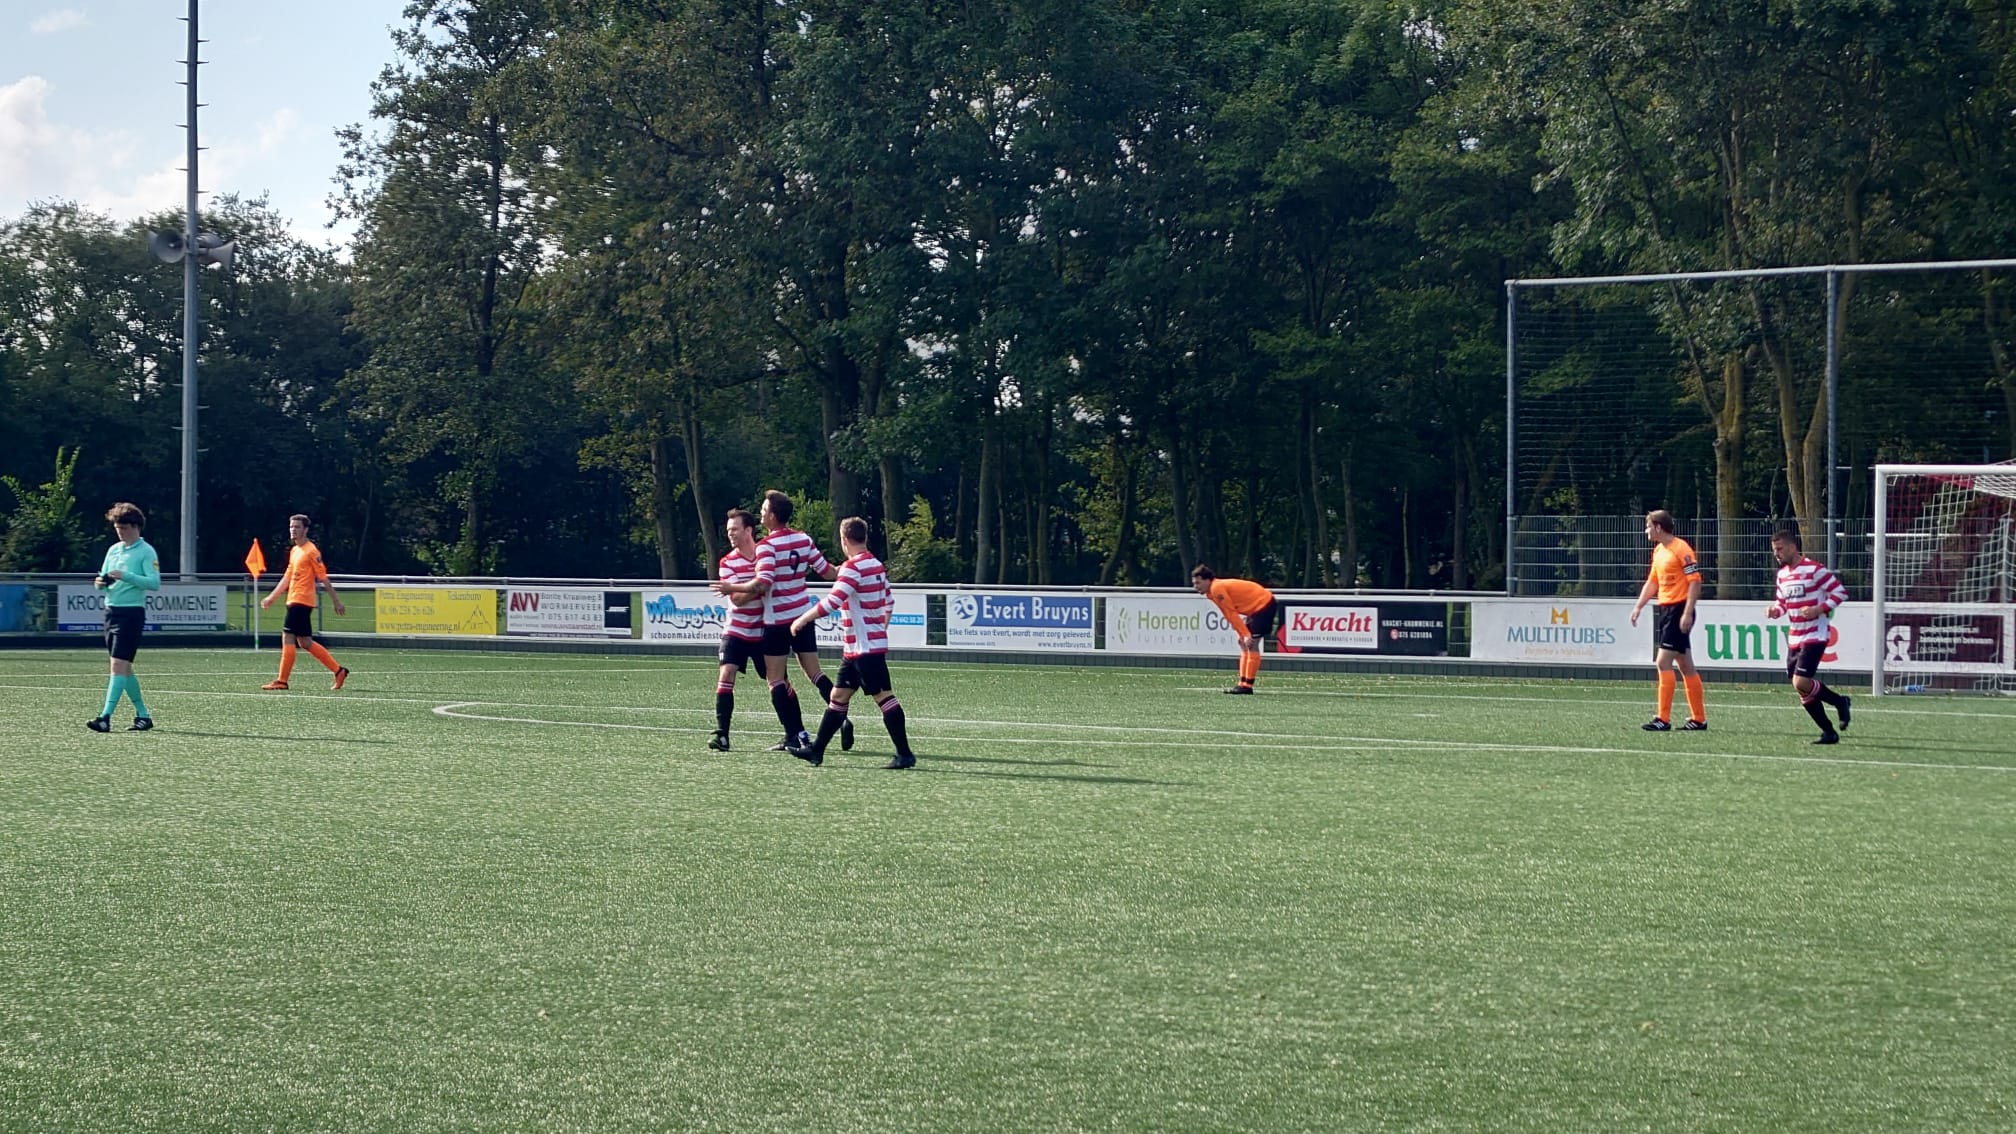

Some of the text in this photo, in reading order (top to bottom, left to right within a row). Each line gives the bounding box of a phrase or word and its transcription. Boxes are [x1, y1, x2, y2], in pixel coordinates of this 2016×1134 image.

[789, 550, 800, 576] 9
[145, 595, 217, 610] ROMMENIE
[396, 590, 434, 602] Engineering
[510, 592, 540, 612] AVV
[982, 595, 1089, 625] Evert Bruyns
[1138, 610, 1236, 631] Horend Go
[1292, 612, 1372, 632] Kracht
[650, 630, 722, 640] schoonmaakdienste
[1046, 632, 1061, 640] zorg
[1137, 634, 1198, 644] luistert
[1507, 626, 1616, 644] MULTITUBES
